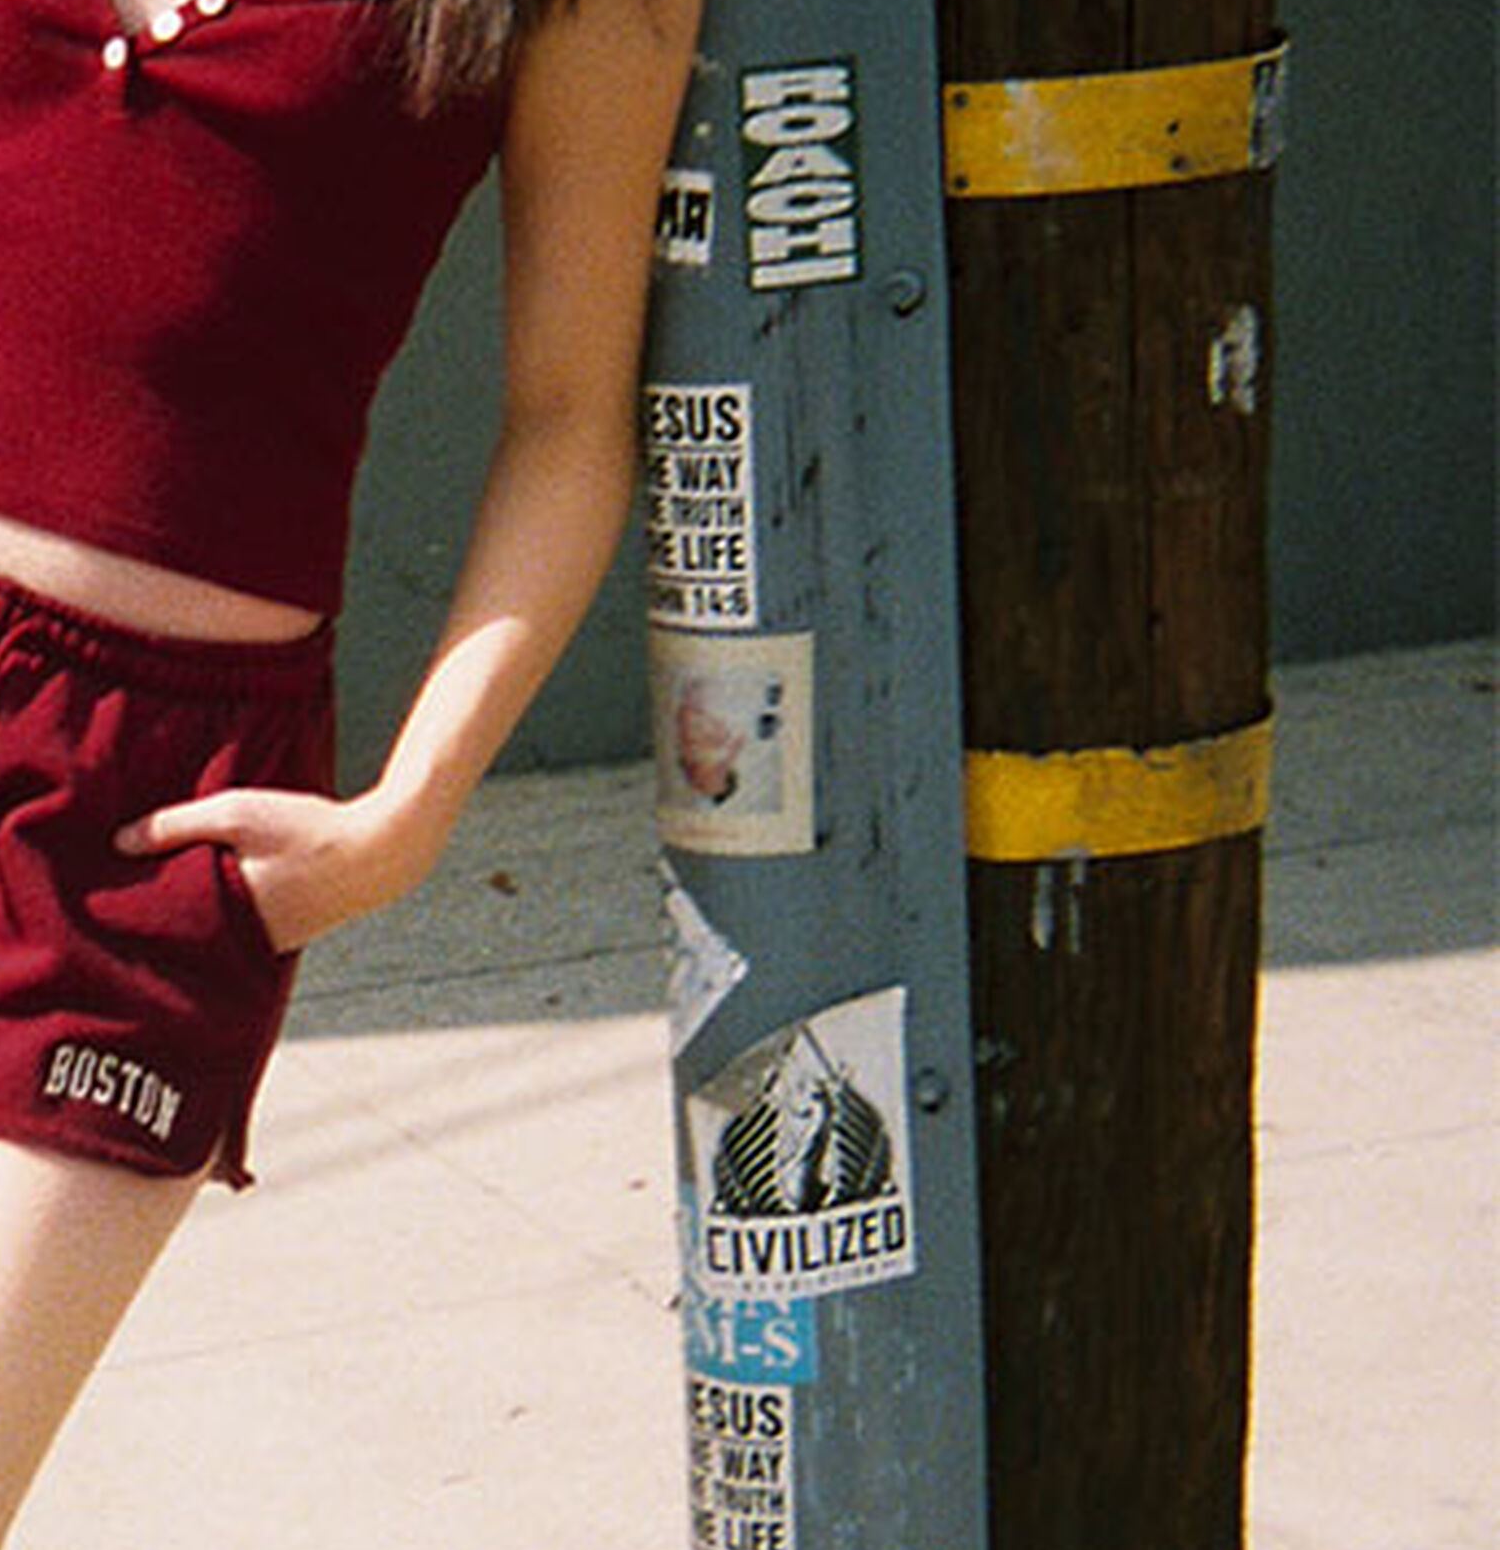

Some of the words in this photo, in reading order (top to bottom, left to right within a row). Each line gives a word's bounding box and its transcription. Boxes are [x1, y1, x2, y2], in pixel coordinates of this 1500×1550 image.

[681, 534, 746, 571] LIFE
[43, 1043, 182, 1142] BOSTON
[707, 1206, 906, 1275] CIVILIZED
